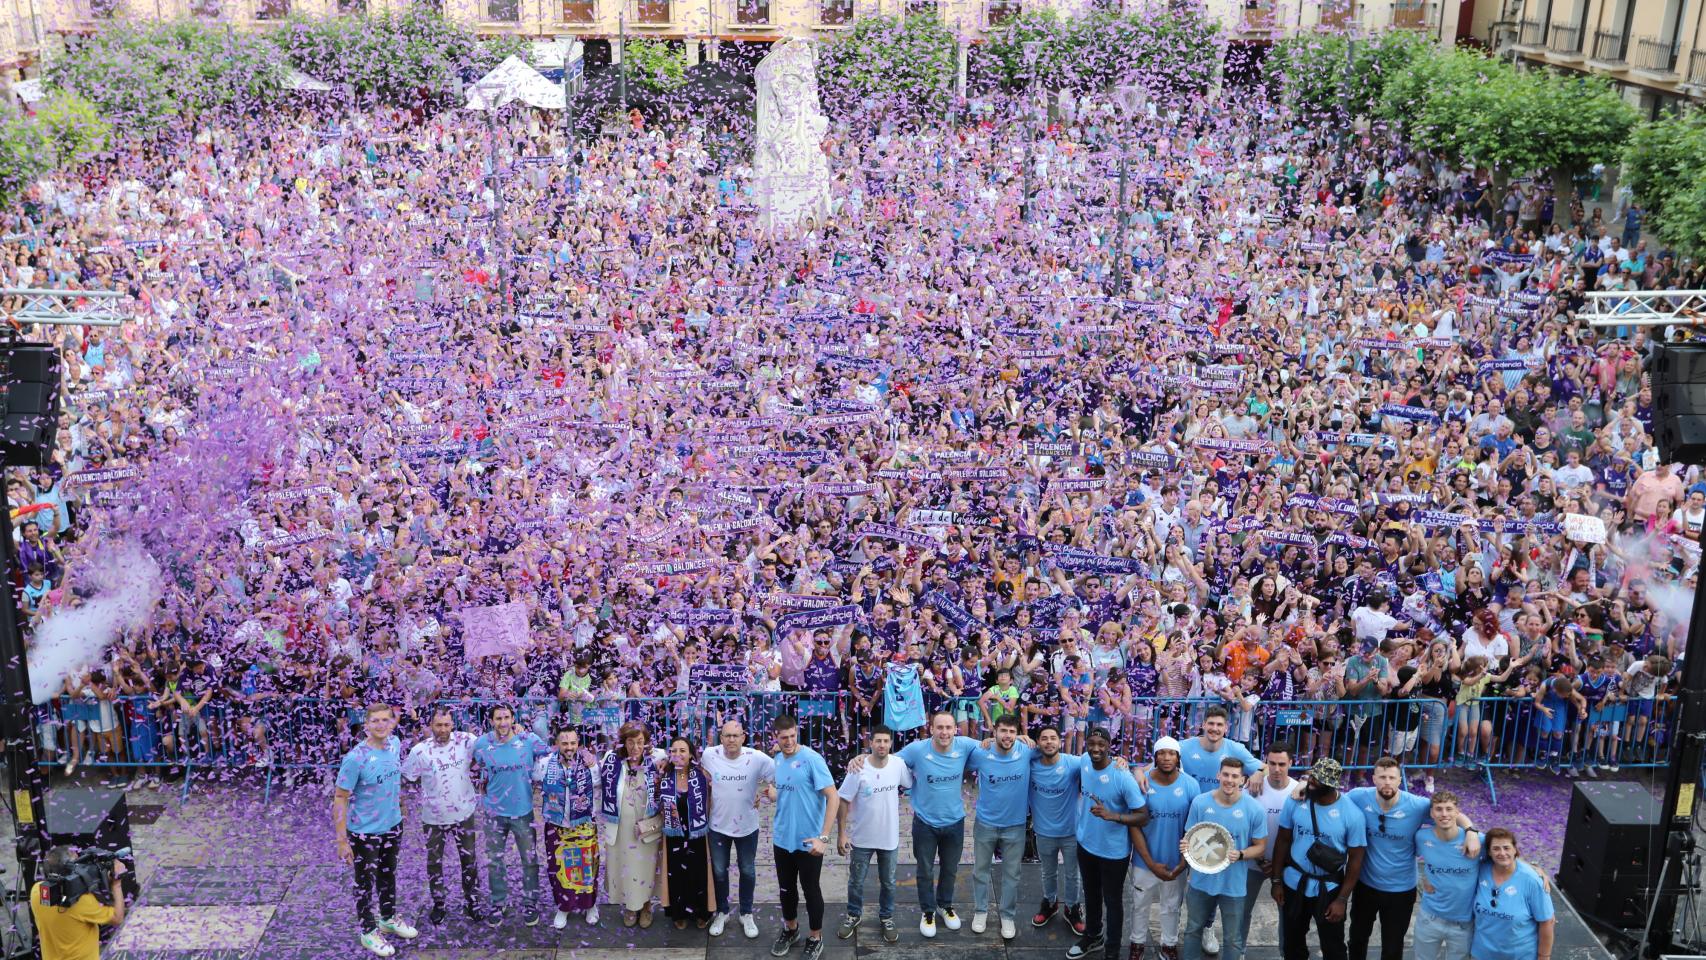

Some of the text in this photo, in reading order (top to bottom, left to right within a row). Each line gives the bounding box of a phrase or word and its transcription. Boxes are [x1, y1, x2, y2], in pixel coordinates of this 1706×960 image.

[1034, 442, 1072, 453] PALENCIA
[1131, 453, 1169, 463] PALENCIA
[1420, 517, 1461, 528] PALENCI
[935, 773, 961, 783] zunder
[997, 774, 1023, 783] zunder
[873, 785, 897, 794] zunder
[1436, 866, 1470, 875] zunder
[1481, 906, 1515, 920] zunder
